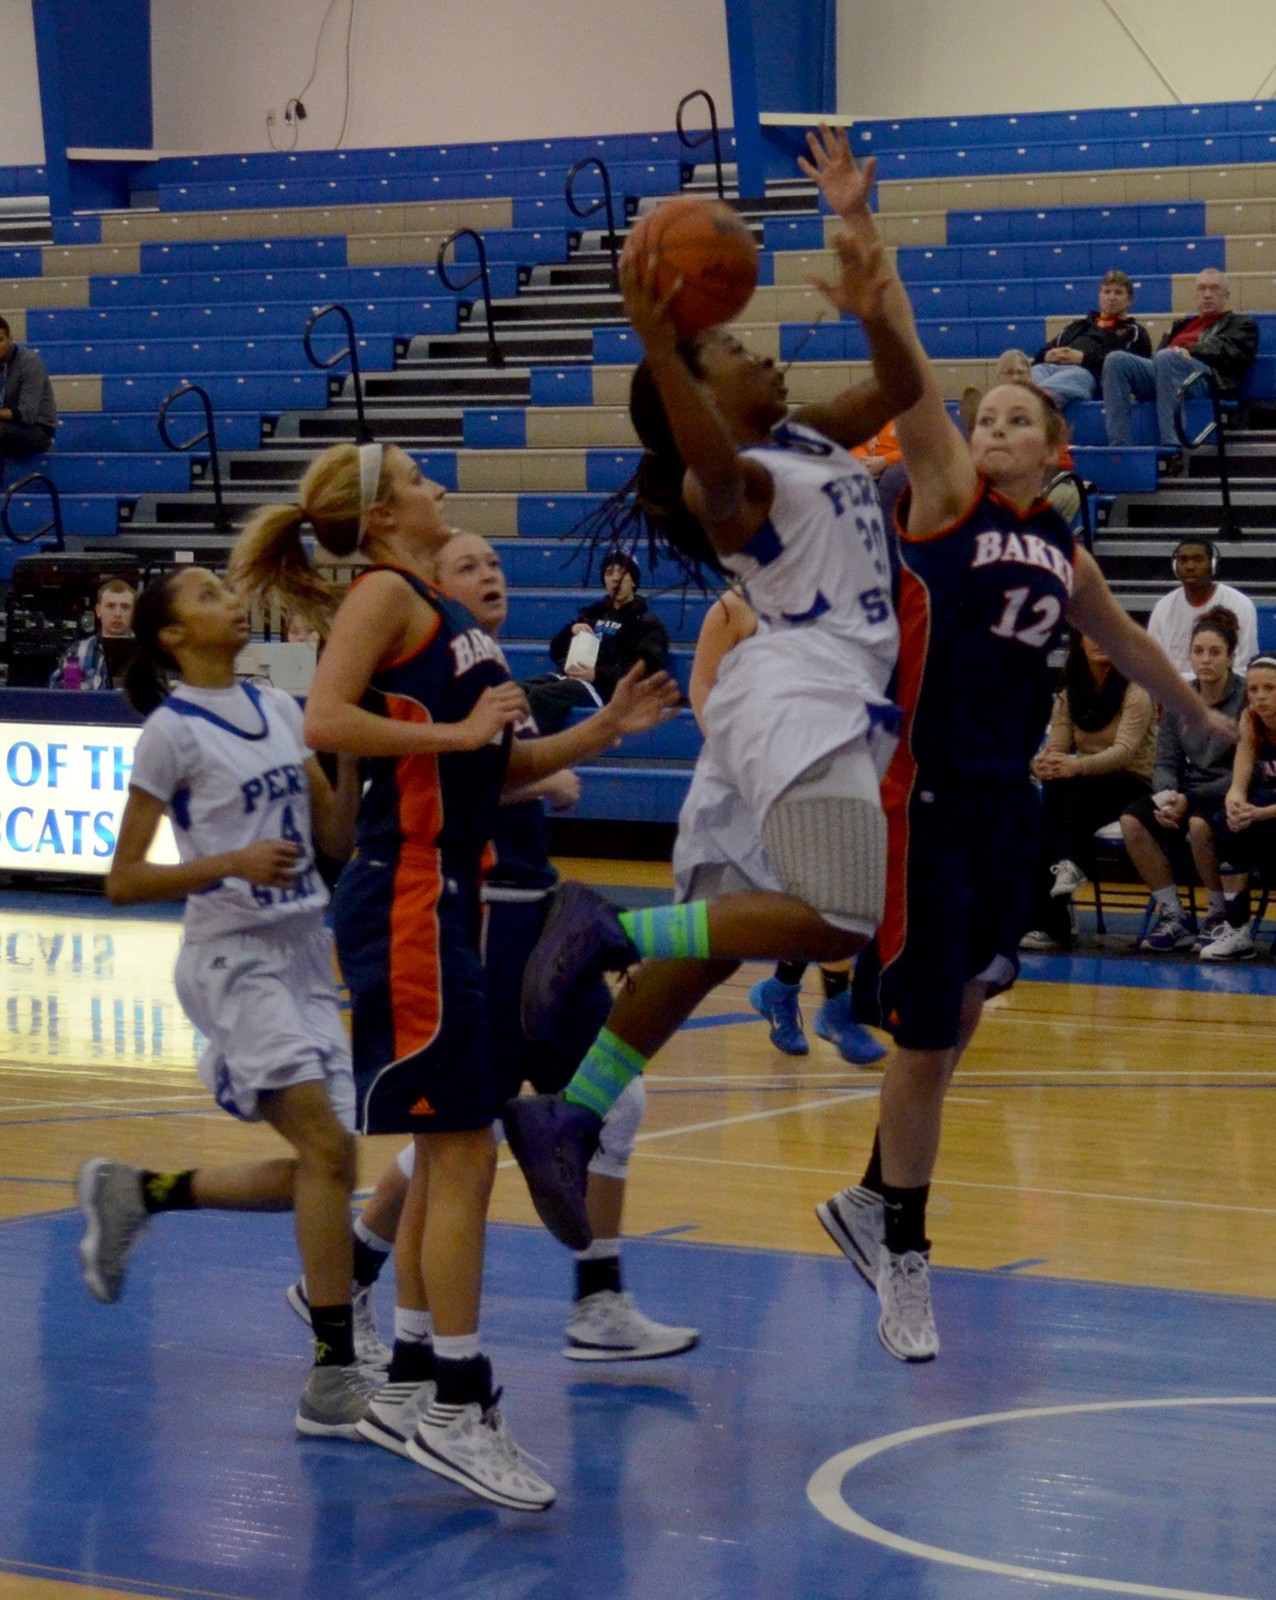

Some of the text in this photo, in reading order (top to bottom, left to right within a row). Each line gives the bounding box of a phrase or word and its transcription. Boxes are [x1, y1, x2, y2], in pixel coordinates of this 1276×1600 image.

[989, 586, 1061, 648] 12
[6, 741, 135, 791] OF TH
[241, 764, 303, 815] PER
[0, 806, 116, 857] CATS
